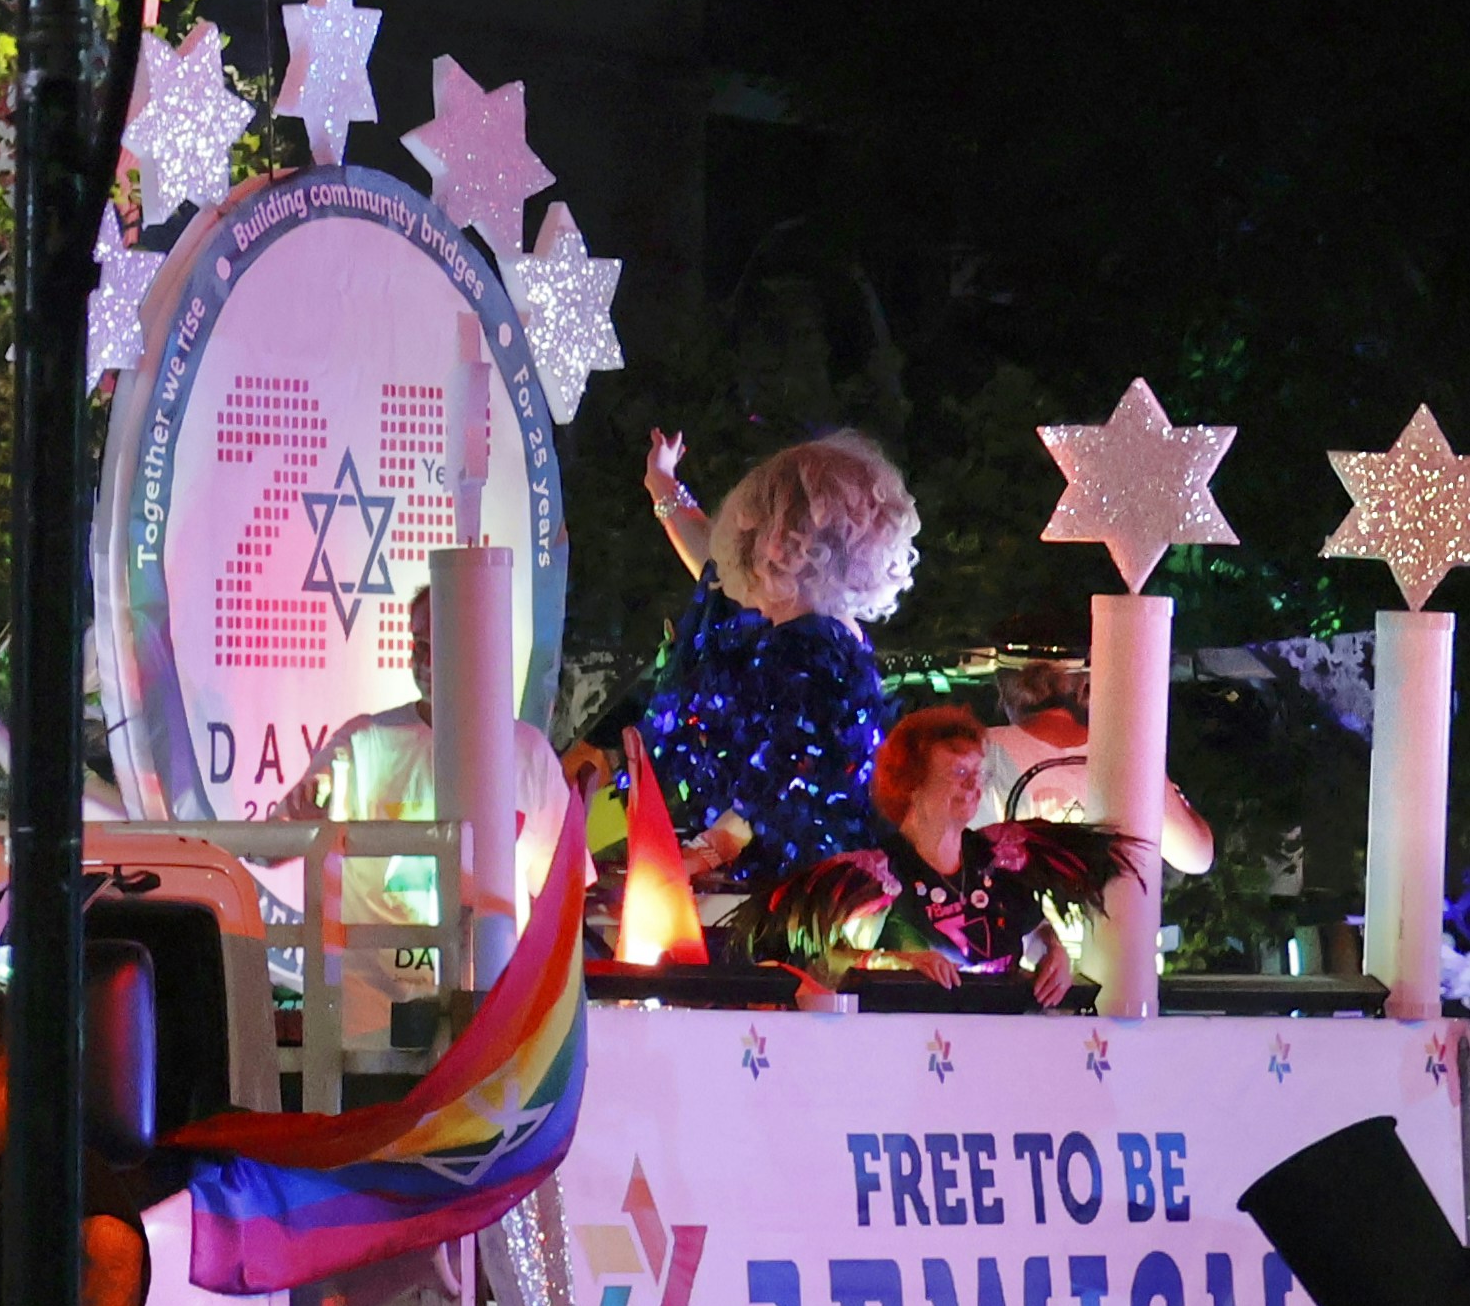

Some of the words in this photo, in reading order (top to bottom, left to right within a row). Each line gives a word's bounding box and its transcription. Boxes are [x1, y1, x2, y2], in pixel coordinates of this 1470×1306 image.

[232, 188, 307, 252] Building
[309, 184, 417, 237] community
[420, 216, 485, 300] bridges
[177, 297, 206, 352] rise
[162, 357, 186, 403] we
[513, 364, 533, 419] For
[528, 427, 548, 469] 25
[137, 410, 170, 567] Together
[532, 477, 551, 569] years
[847, 1131, 1004, 1226] FREE
[1014, 1130, 1104, 1225] TO
[1117, 1131, 1190, 1223] BE
